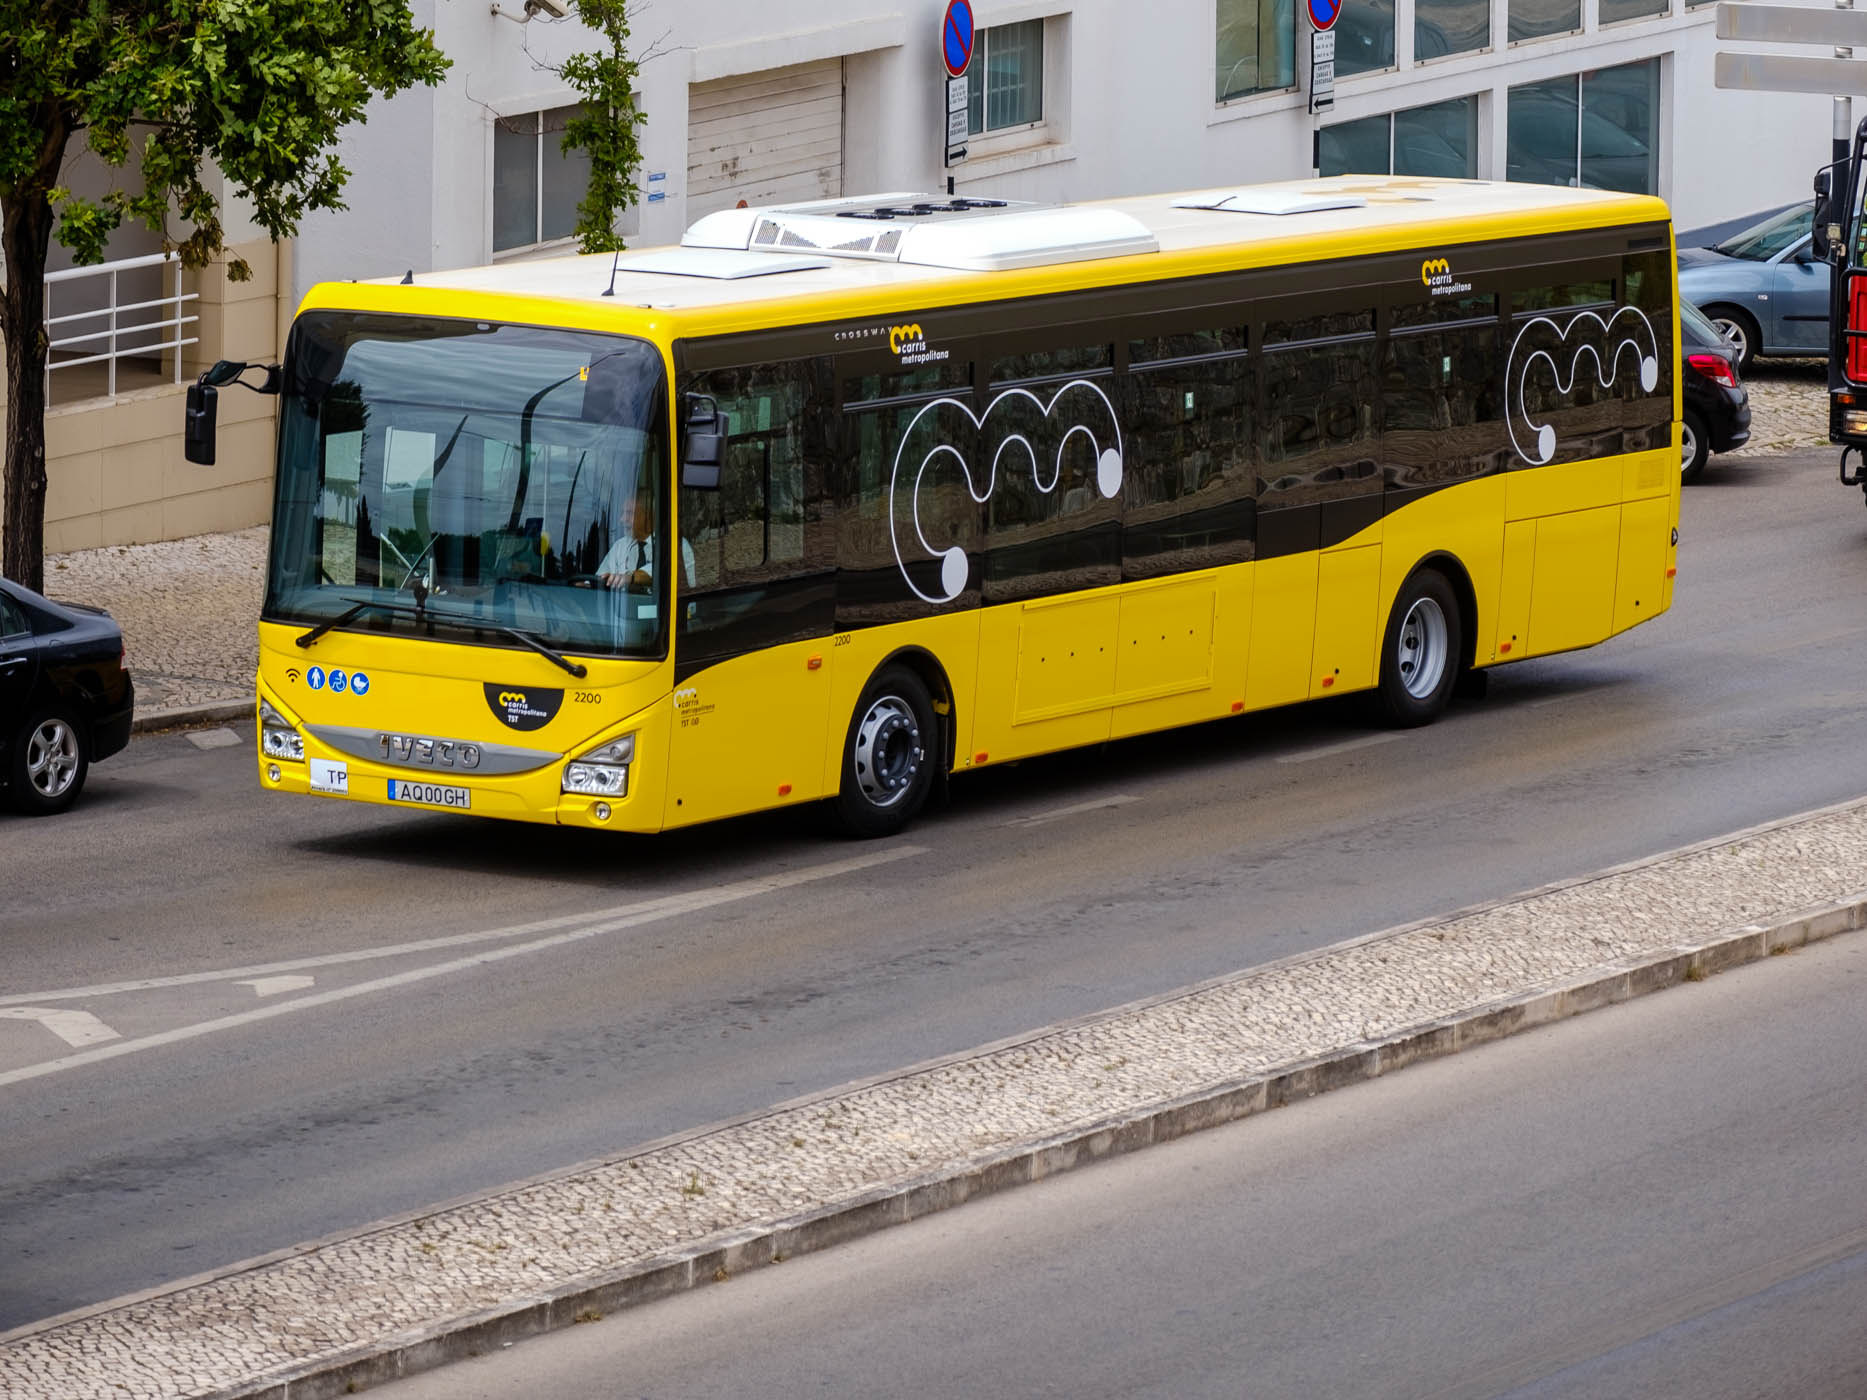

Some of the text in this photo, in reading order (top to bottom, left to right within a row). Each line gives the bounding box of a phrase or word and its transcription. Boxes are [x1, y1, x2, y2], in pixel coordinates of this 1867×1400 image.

[1431, 274, 1452, 286] carris
[1431, 282, 1472, 296] metropolitana
[901, 341, 926, 354] carris
[901, 350, 949, 365] metropolitana
[834, 634, 851, 647] 2200
[574, 692, 602, 705] 2200
[508, 701, 529, 710] carris
[507, 707, 548, 718] metropolitana
[379, 733, 481, 769] IVECO
[327, 769, 347, 785] TP
